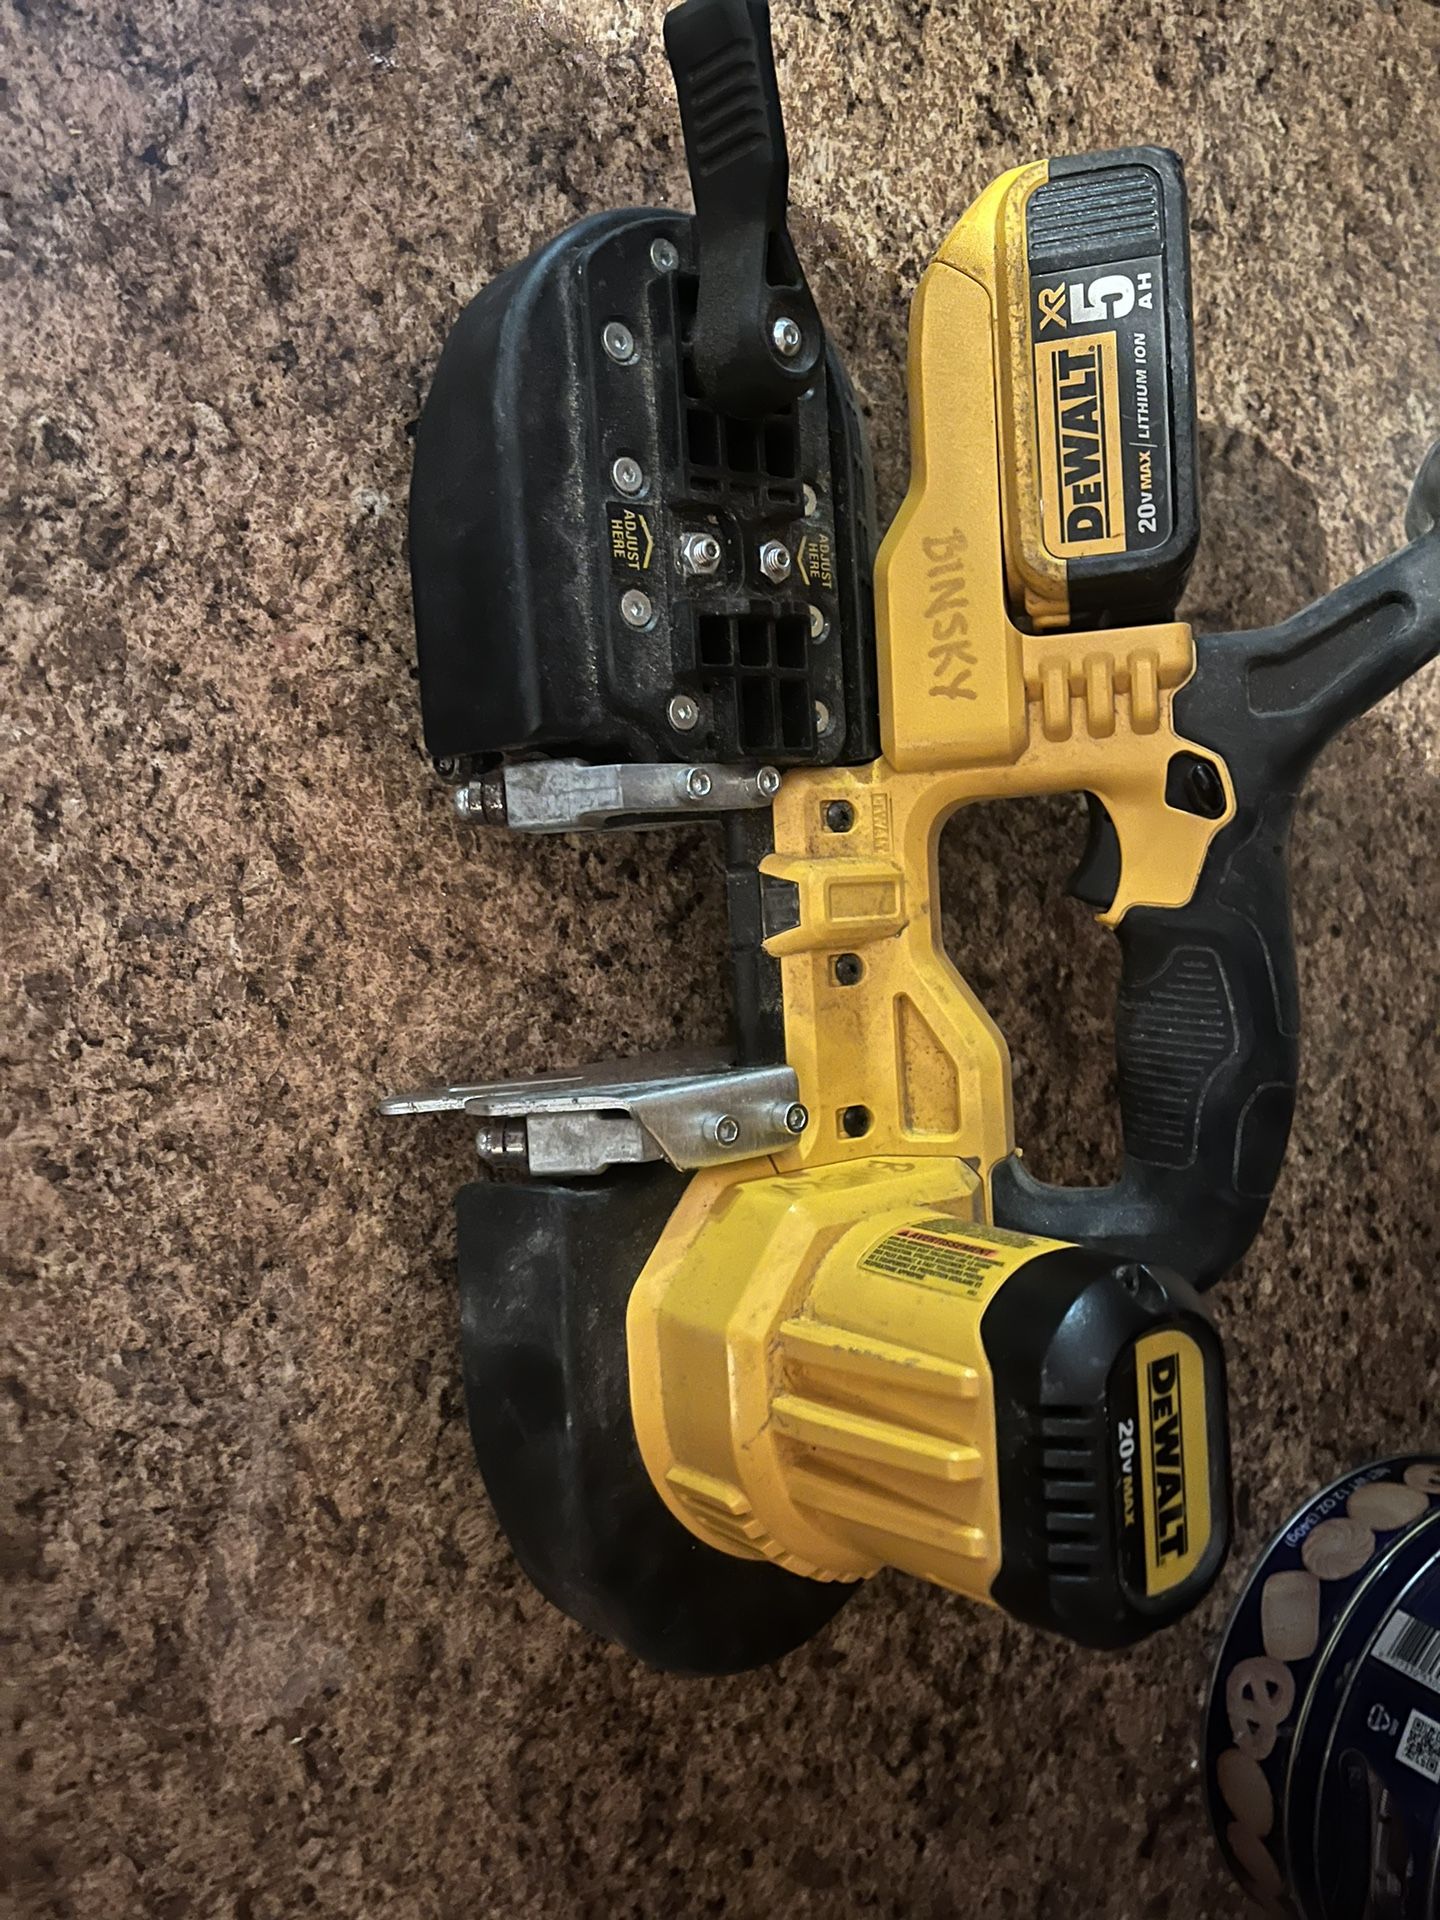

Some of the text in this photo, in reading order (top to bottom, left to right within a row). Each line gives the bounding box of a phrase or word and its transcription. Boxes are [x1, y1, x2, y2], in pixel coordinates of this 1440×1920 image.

[1038, 282, 1067, 330] XR
[1070, 274, 1136, 324] 5
[1137, 272, 1153, 309] AH
[1134, 332, 1146, 364] ION
[1134, 370, 1150, 438] LITHIUM
[611, 519, 626, 558] HERE
[623, 509, 641, 571] ADJUST
[808, 542, 821, 578] HERE
[818, 534, 833, 589] ADJUST
[922, 527, 979, 701] BINSKY
[1150, 1354, 1184, 1558] DEWALT
[1317, 1499, 1337, 1514] OZ
[1333, 1490, 1350, 1499] 12
